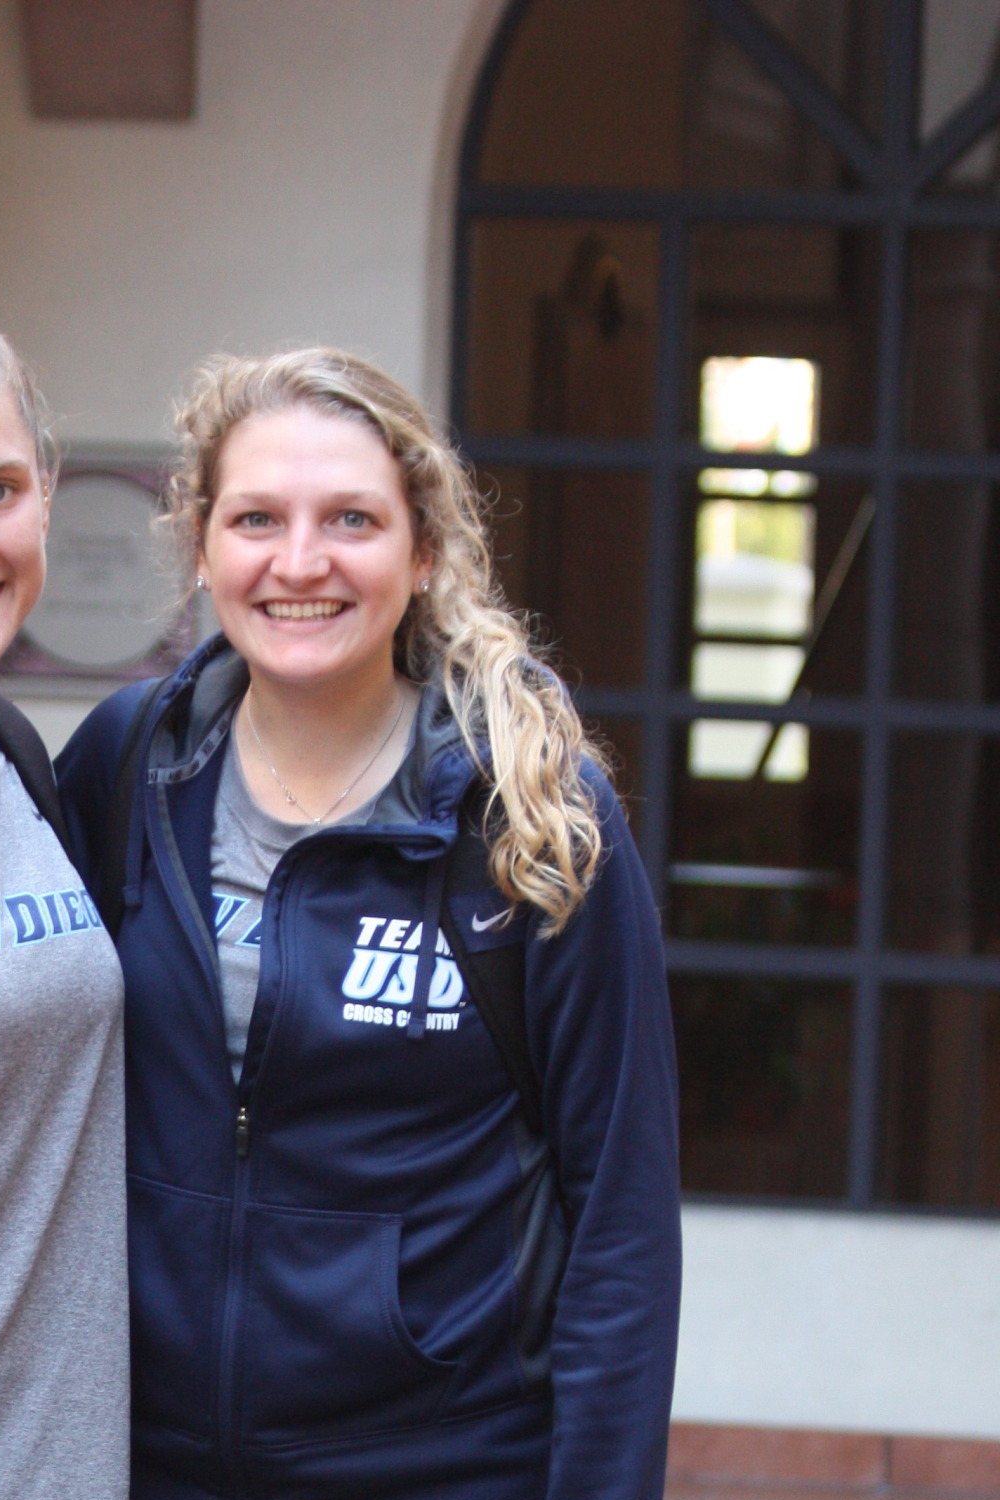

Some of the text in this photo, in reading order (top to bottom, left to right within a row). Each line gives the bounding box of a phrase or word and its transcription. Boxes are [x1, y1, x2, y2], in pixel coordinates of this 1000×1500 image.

[4, 887, 105, 947] DIEG
[341, 948, 464, 1008] USD
[342, 1003, 460, 1031] CROSS CNTRY
